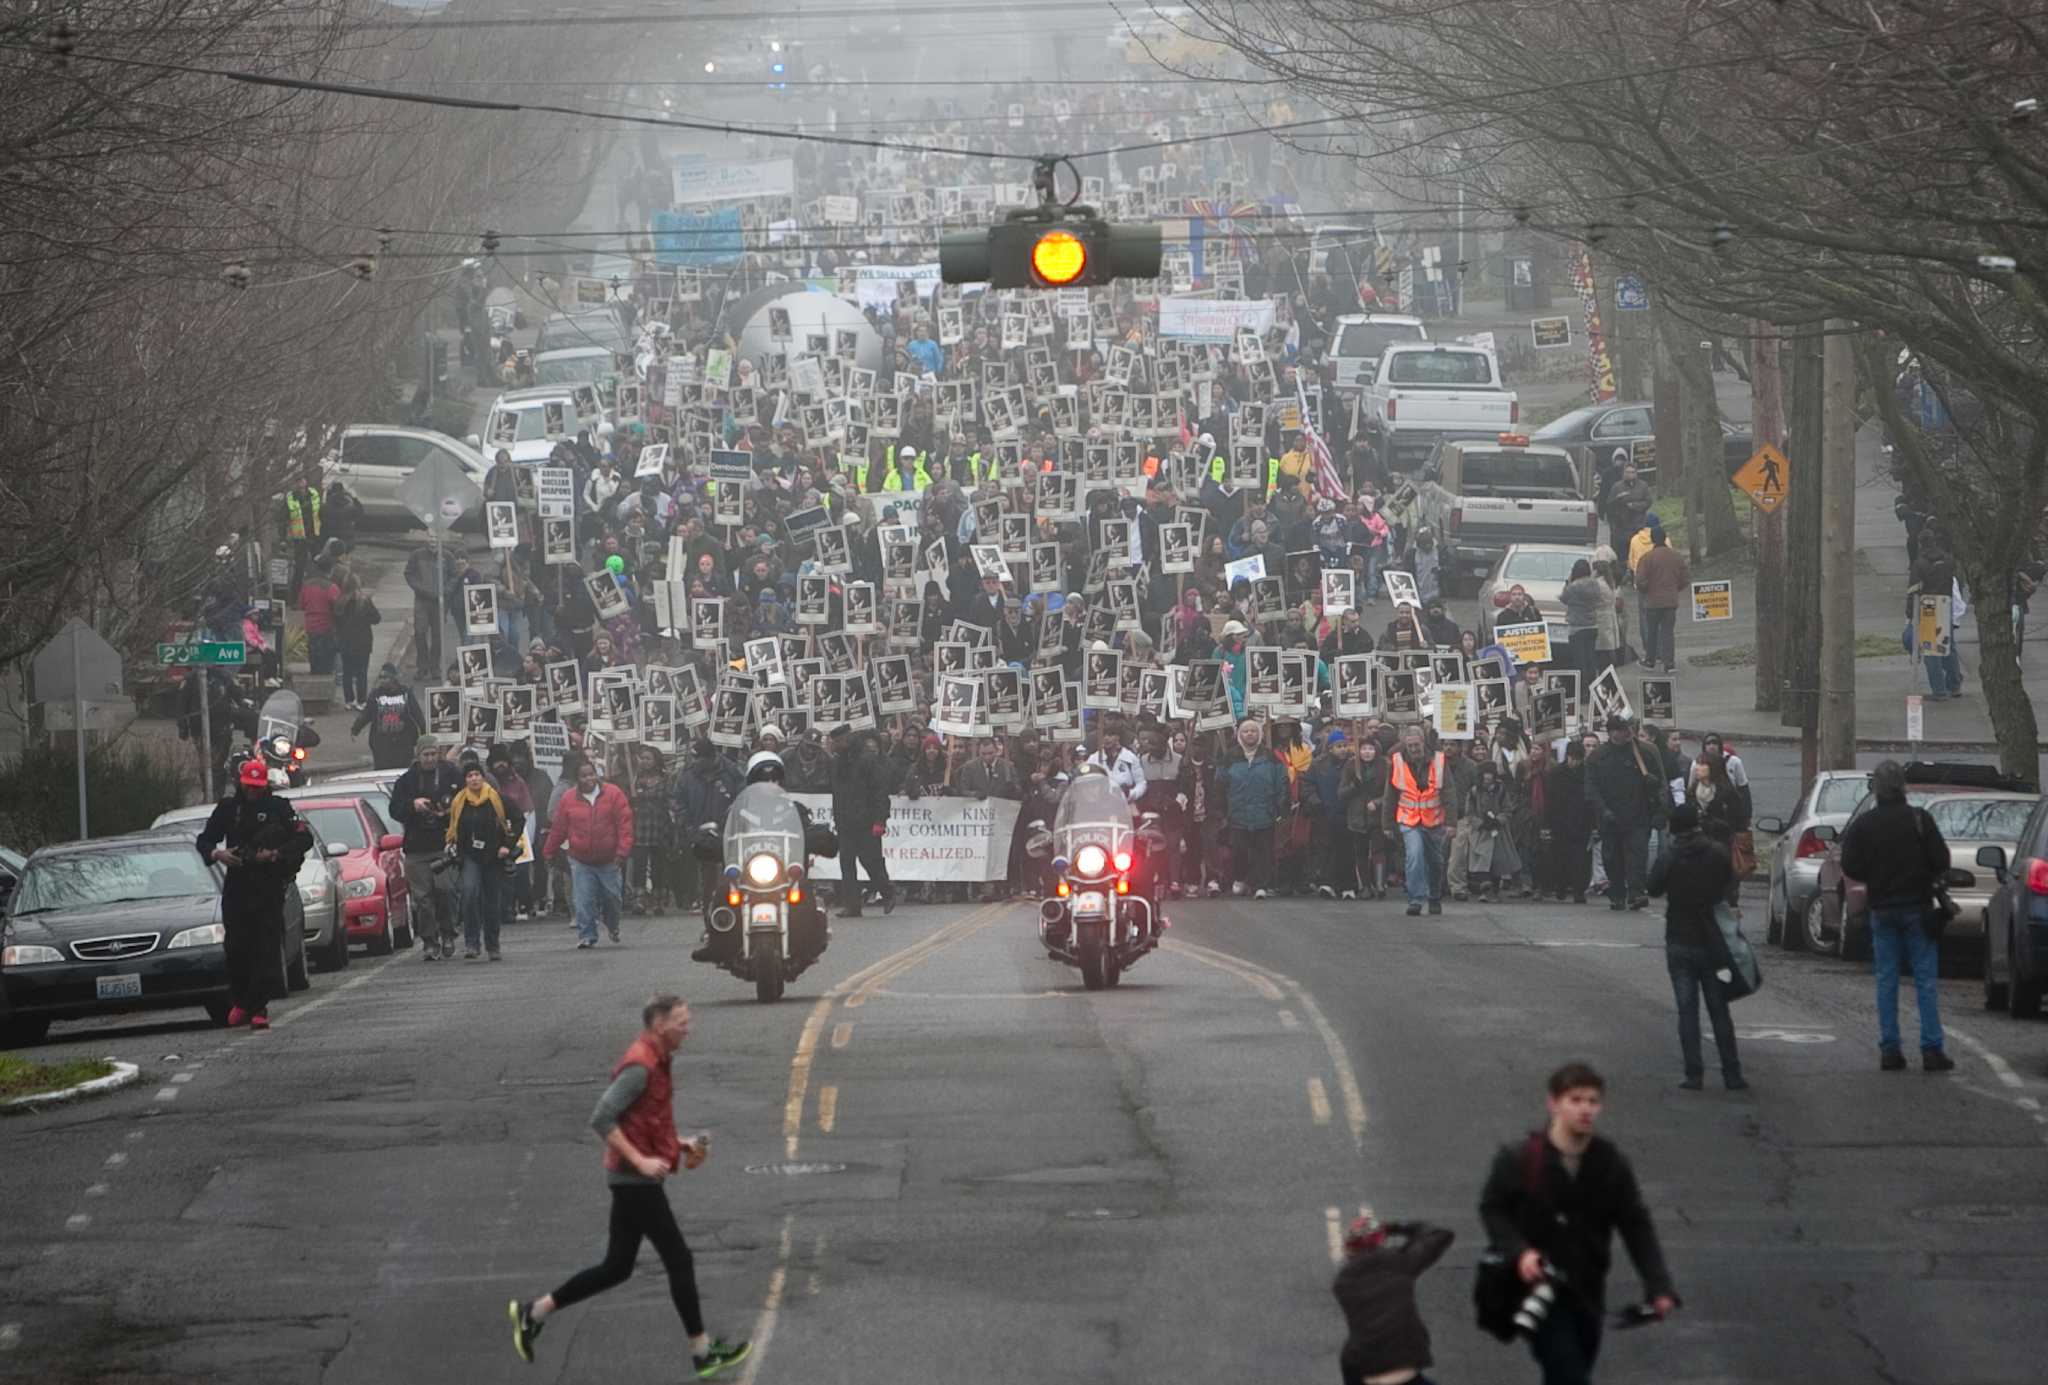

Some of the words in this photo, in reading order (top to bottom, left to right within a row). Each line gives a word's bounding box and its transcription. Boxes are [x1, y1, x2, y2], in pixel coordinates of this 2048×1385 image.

[540, 487, 571, 495] WEAPONS
[1699, 584, 1725, 593] JUSTICE
[1503, 625, 1540, 637] JUSTICE
[1501, 639, 1545, 648] ANITATION
[218, 648, 240, 660] Ave
[534, 724, 563, 735] ABOLISH
[535, 735, 566, 745] NUCLEAR
[890, 808, 932, 821] THER
